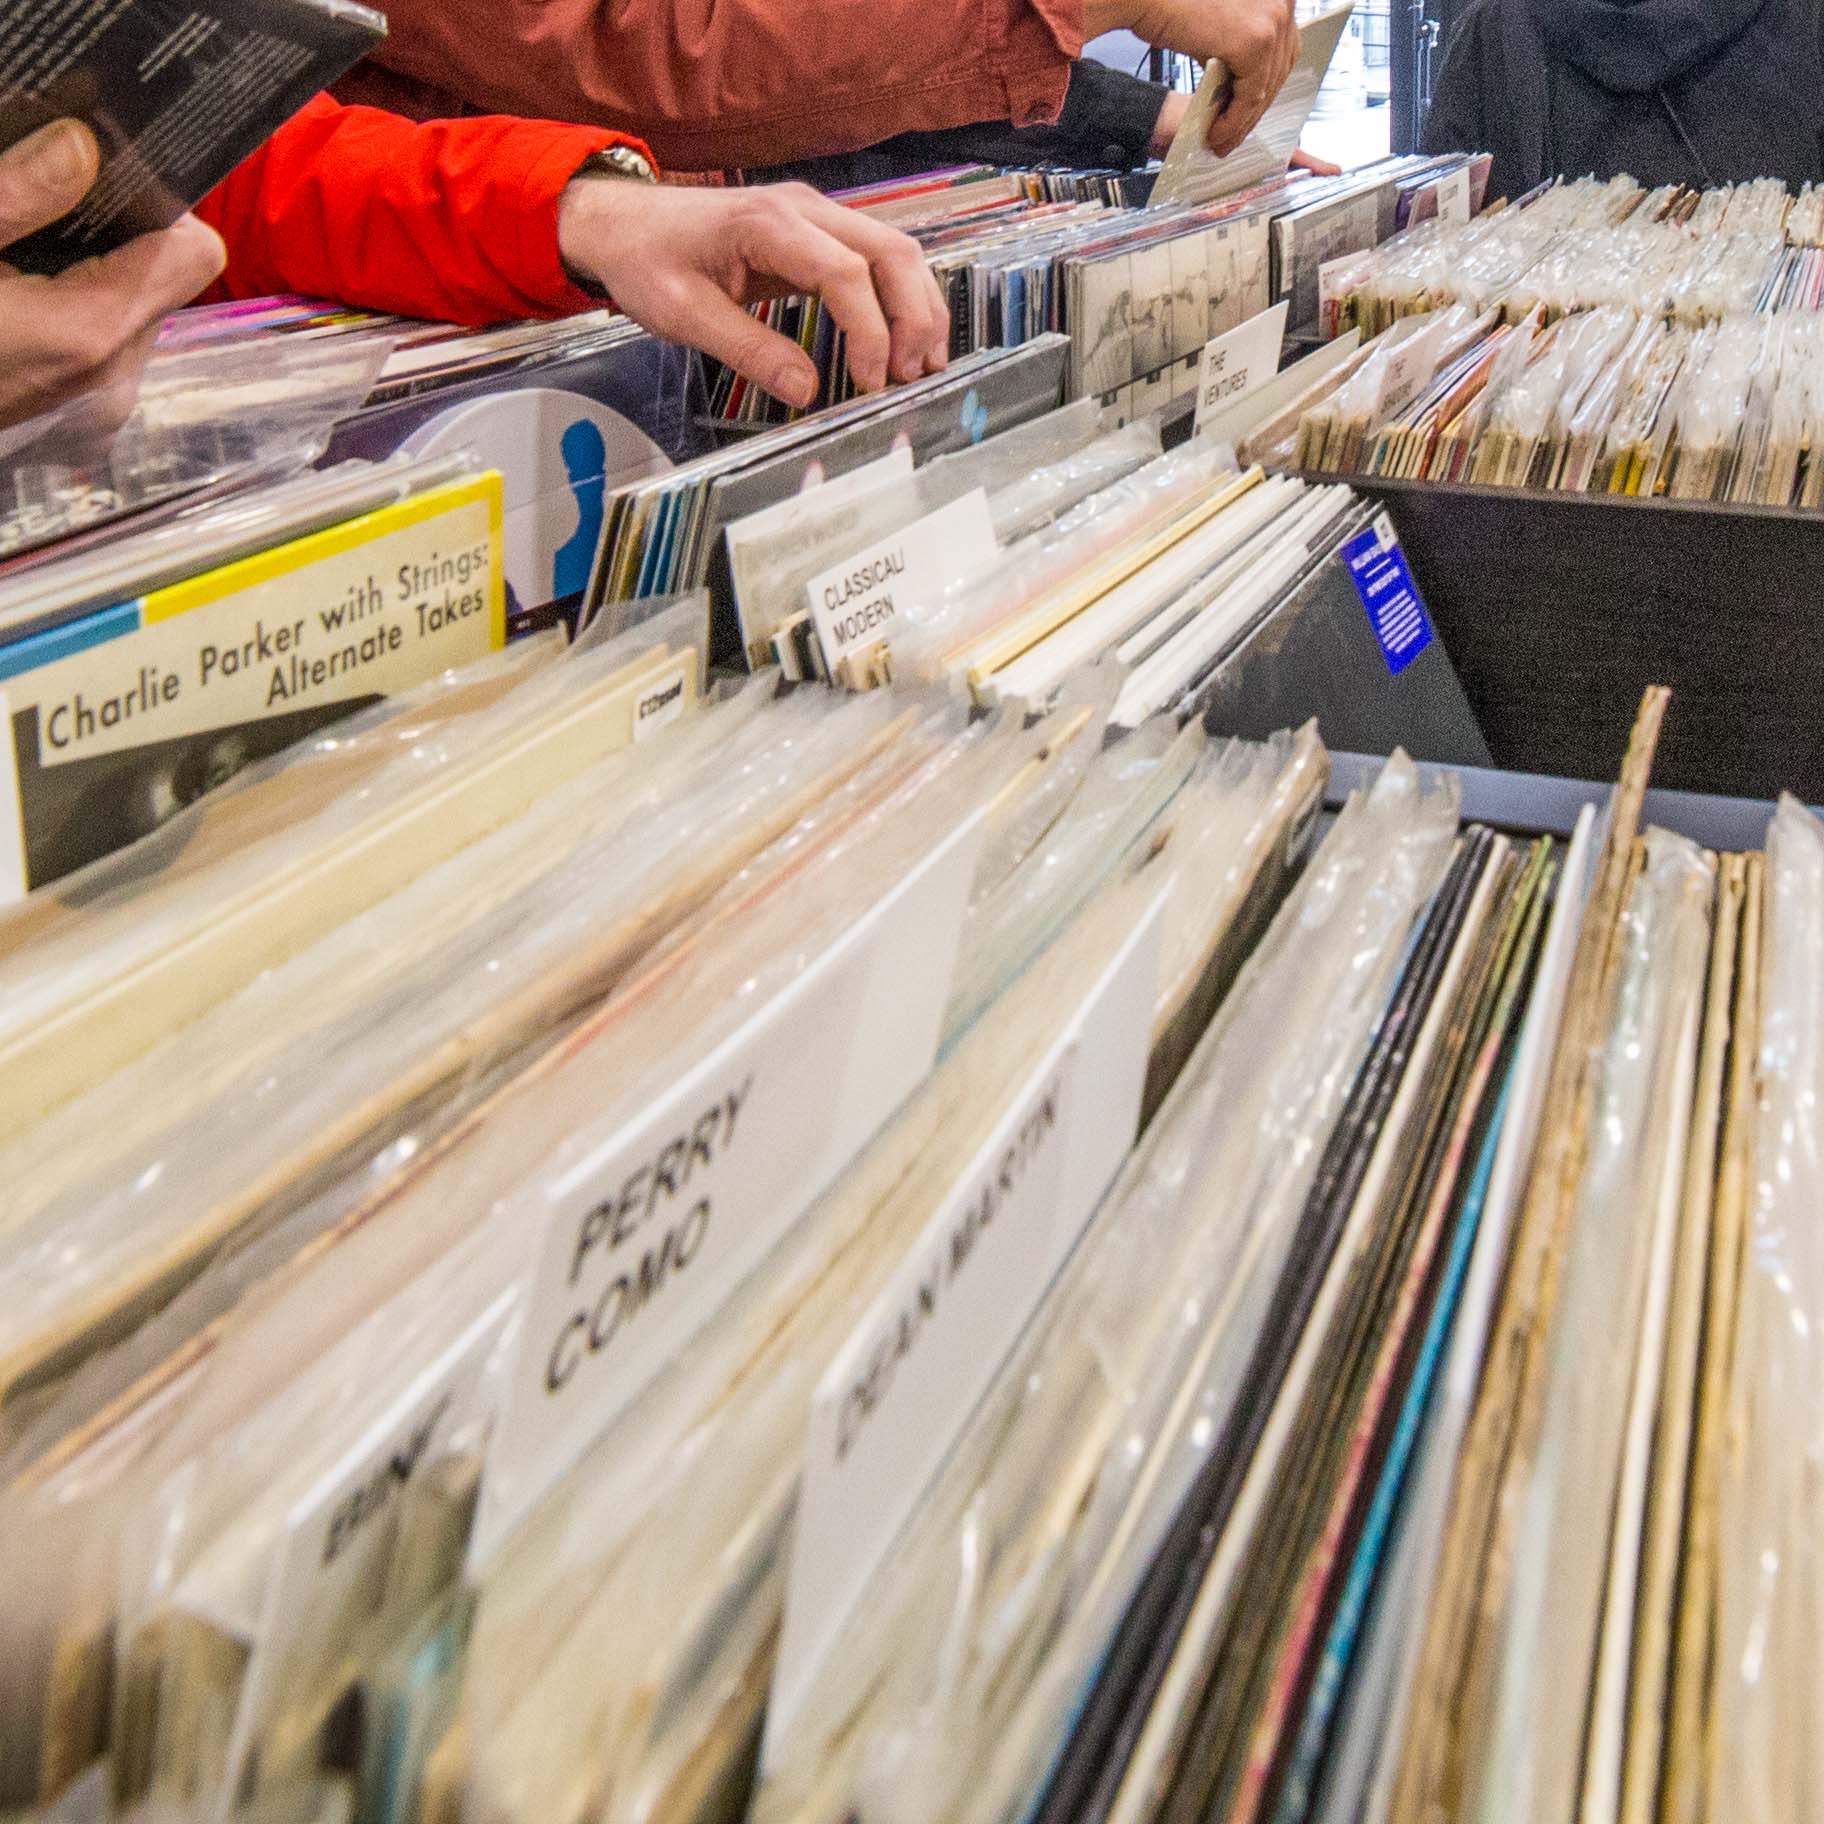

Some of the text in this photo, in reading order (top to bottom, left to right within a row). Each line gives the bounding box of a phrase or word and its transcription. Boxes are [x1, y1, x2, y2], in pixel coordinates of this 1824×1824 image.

[44, 542, 490, 750] Charlie Parker with Strings:
[264, 589, 485, 708] Alternate Takes
[823, 547, 907, 612] CLASSICAL/
[832, 593, 897, 647] MODERN
[568, 1074, 754, 1289] PERRY
[834, 1048, 1074, 1464] DEAN MARTIN
[543, 1192, 711, 1396] COMO
